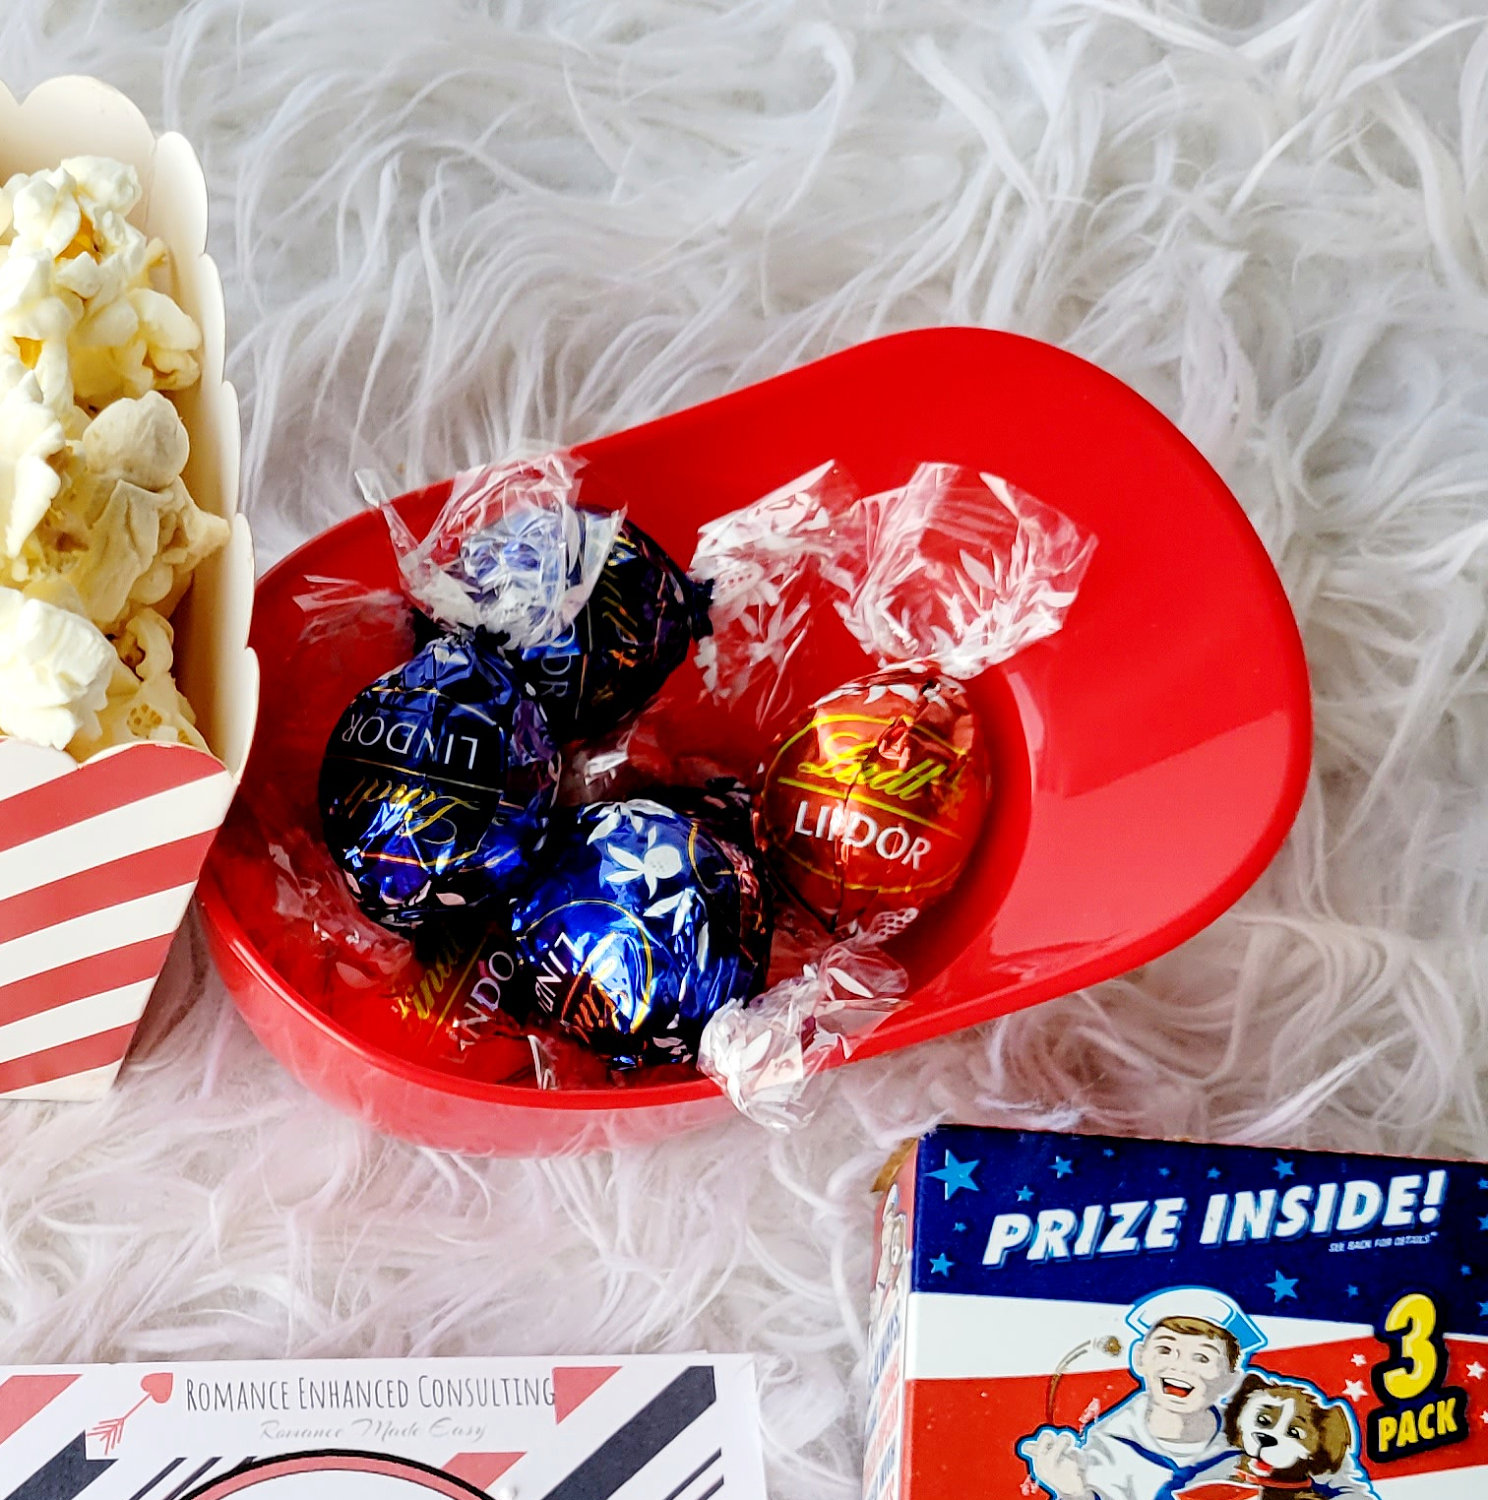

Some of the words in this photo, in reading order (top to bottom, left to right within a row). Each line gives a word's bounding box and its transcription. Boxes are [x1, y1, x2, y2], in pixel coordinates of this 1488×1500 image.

[440, 951, 514, 1063] LINDO
[983, 1196, 1186, 1266] PRIZE
[1200, 1169, 1449, 1245] INSIDE!
[1382, 1294, 1438, 1400] 3
[186, 1377, 290, 1413] ROMANCE
[298, 1376, 409, 1410] ENHANCED
[418, 1374, 556, 1409] CONSULTING
[259, 1419, 344, 1441] Romance
[351, 1417, 419, 1439] Made
[428, 1416, 487, 1443] Easy
[1377, 1396, 1459, 1452] PACK
